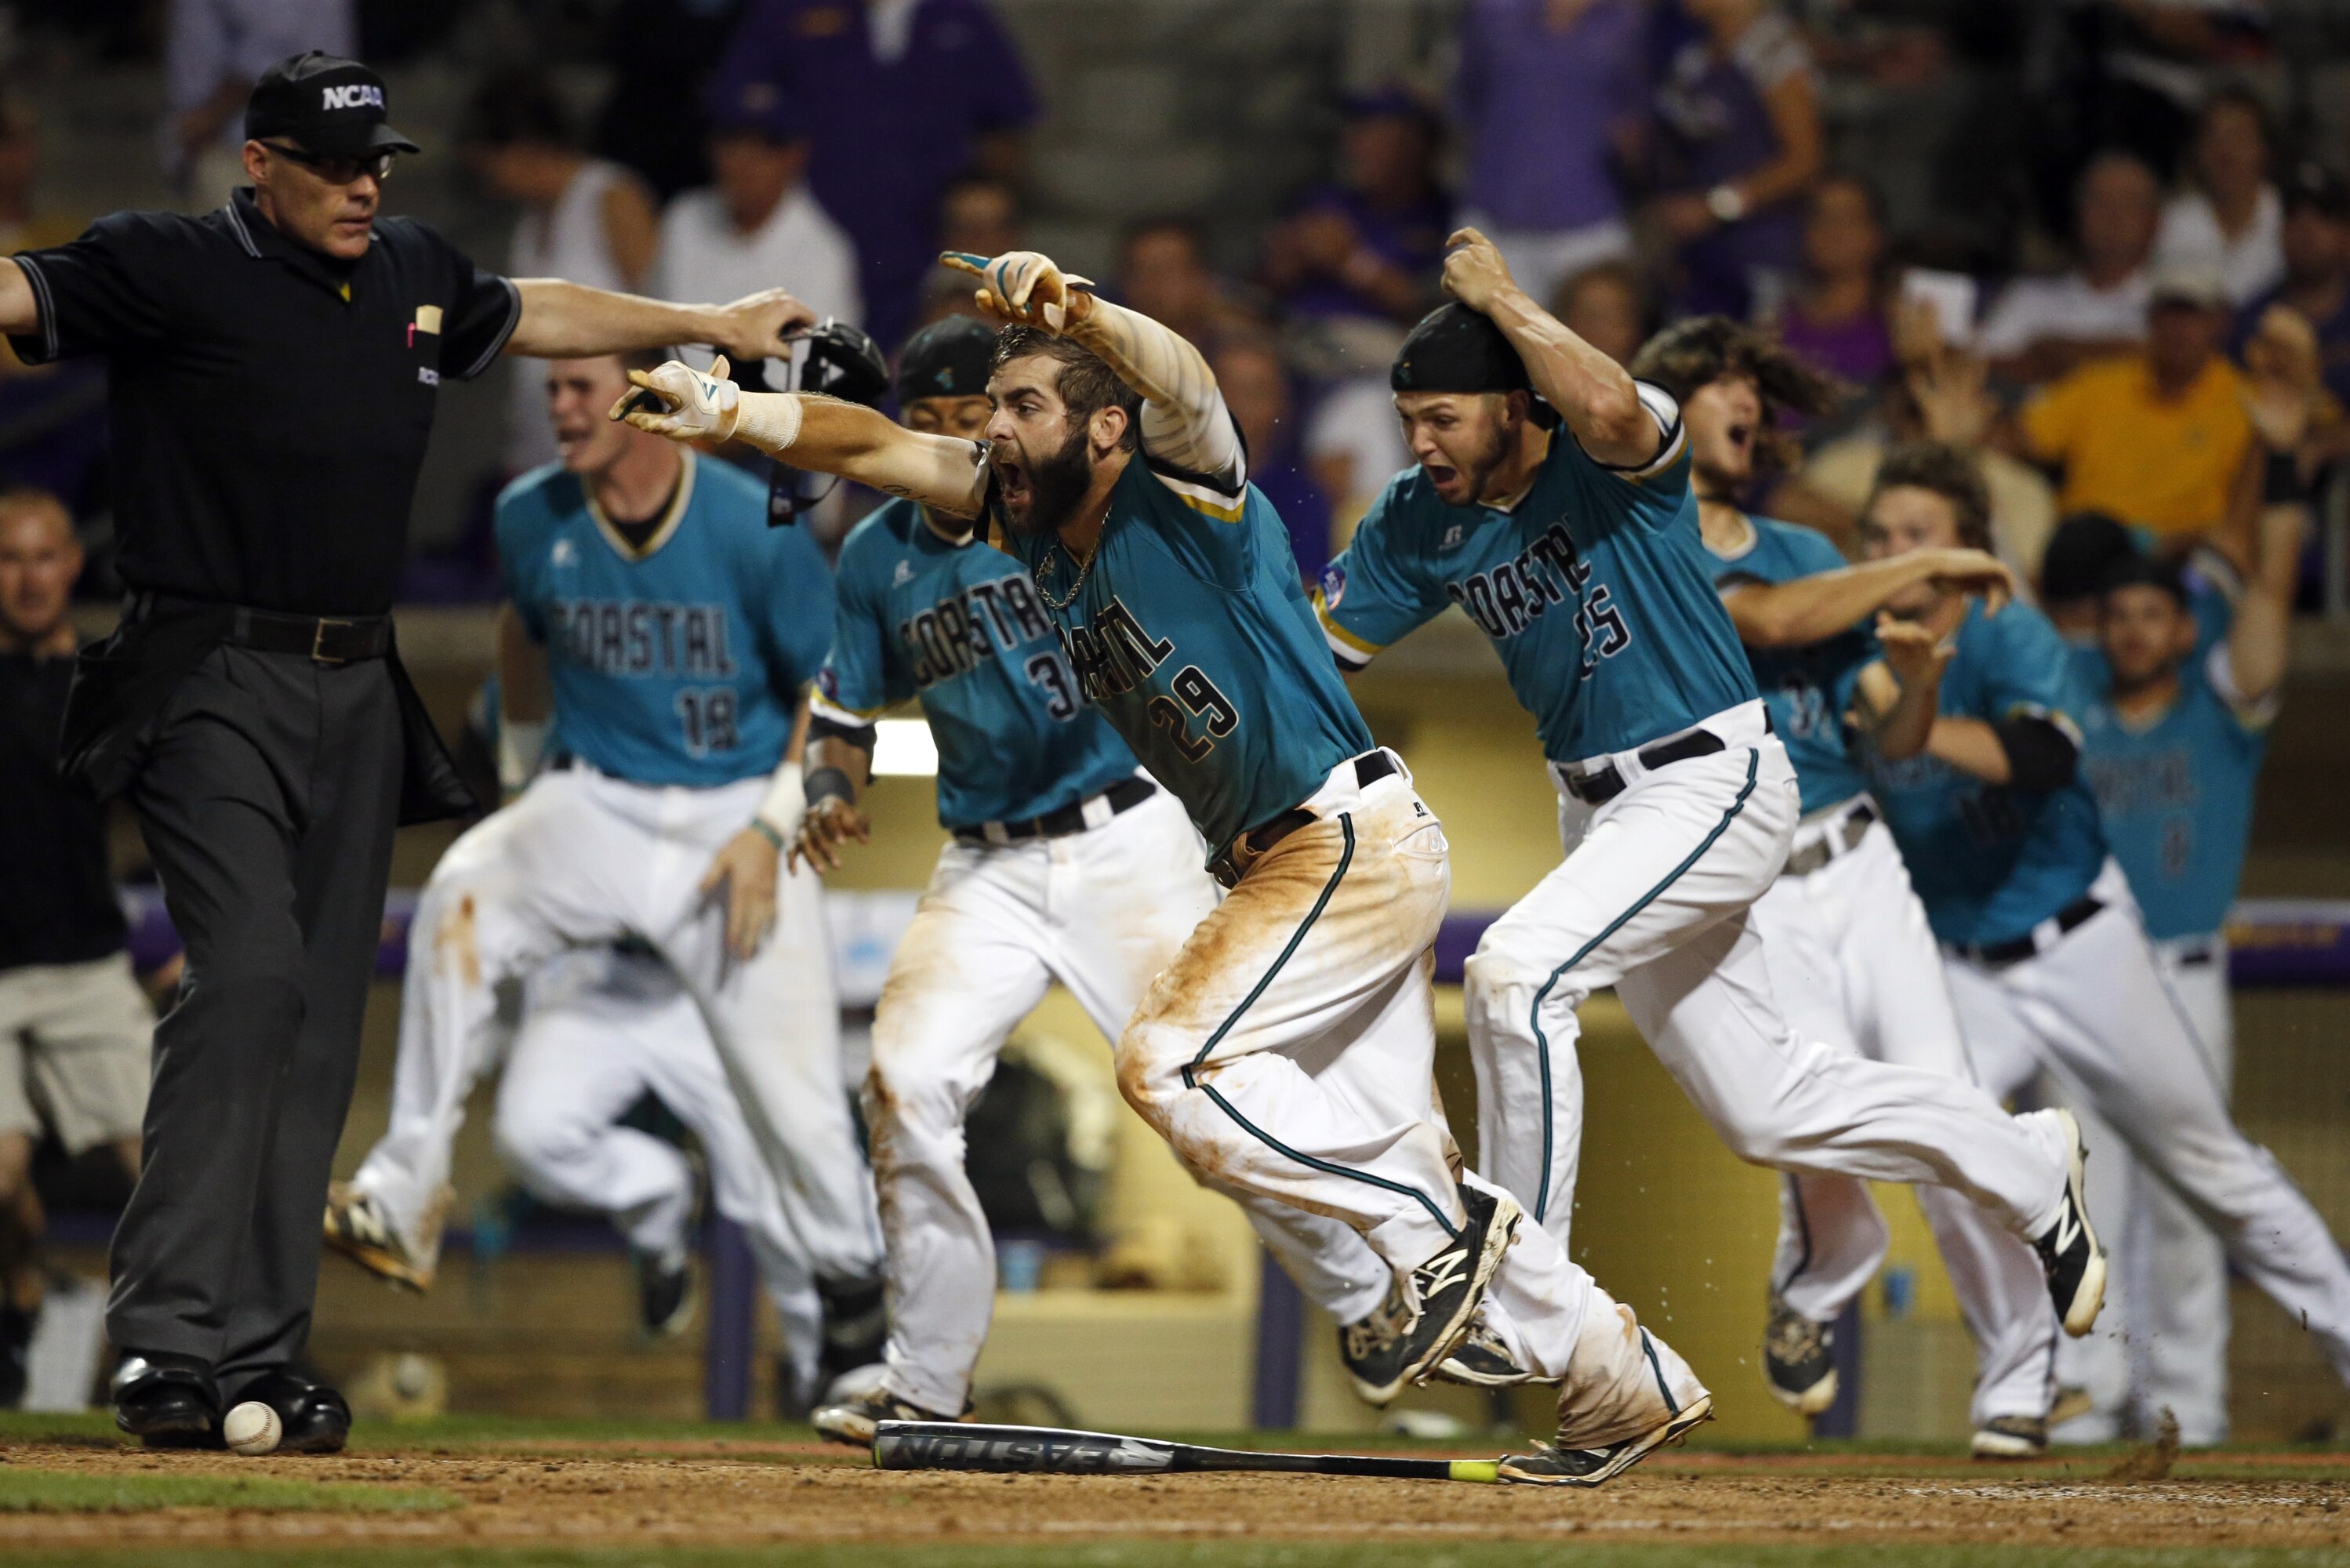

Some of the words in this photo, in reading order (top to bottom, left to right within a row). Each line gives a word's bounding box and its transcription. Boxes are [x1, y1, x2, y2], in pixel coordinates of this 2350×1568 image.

[322, 84, 385, 111] NCAA
[1146, 664, 1240, 765] 29
[887, 1437, 1113, 1475] EASTON
